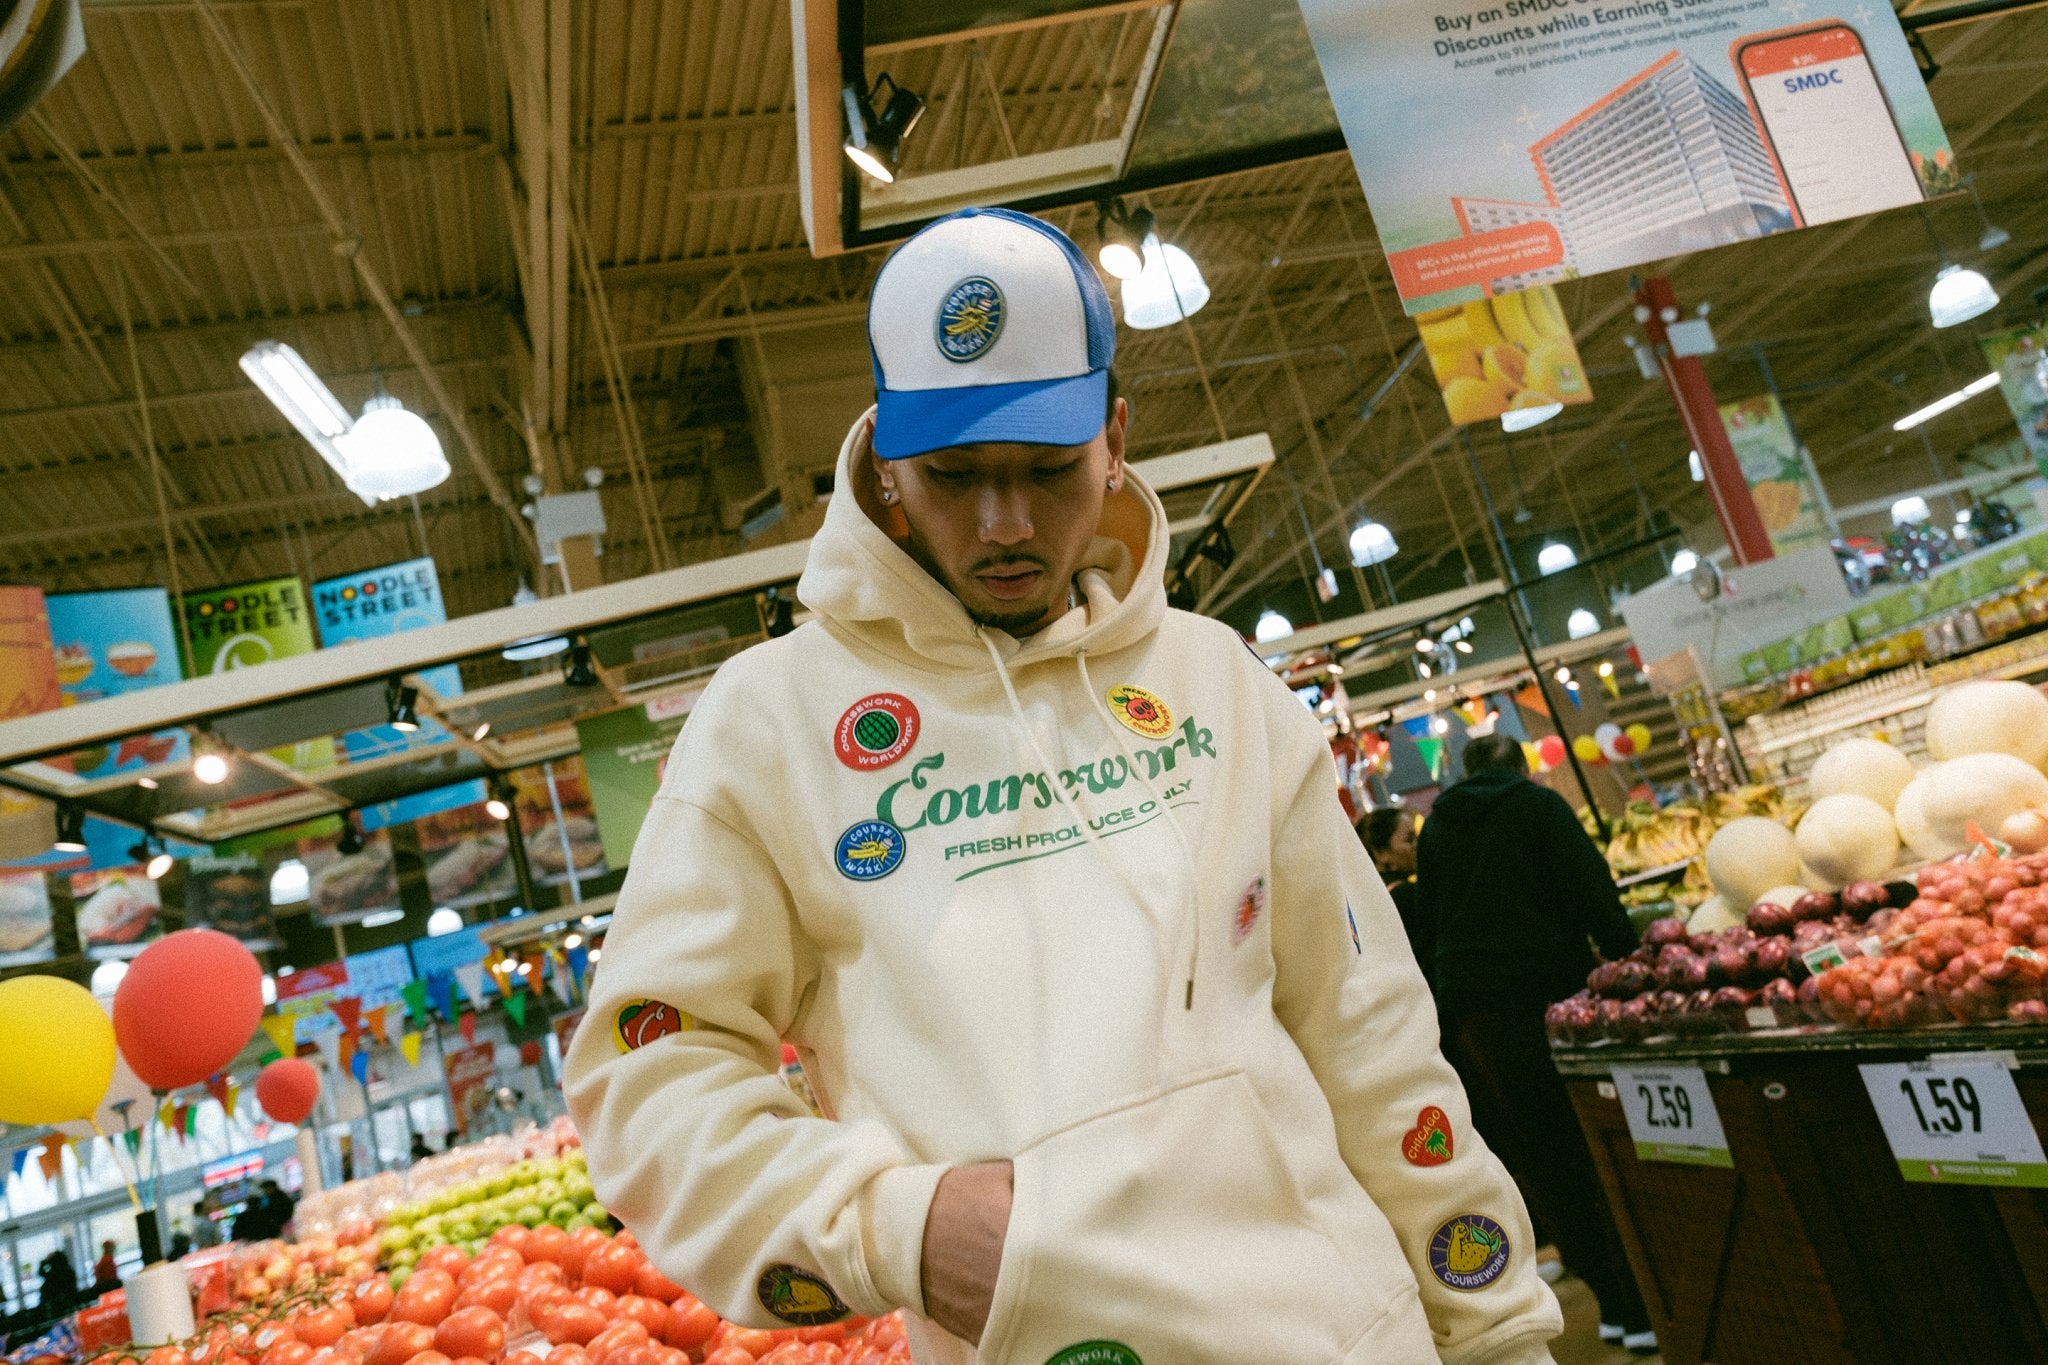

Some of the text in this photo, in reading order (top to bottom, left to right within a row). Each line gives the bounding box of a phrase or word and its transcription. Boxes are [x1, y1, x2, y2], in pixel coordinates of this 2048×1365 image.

[1434, 14, 1472, 32] Buy
[1477, 9, 1503, 23] an
[1434, 26, 1535, 57] Discounts
[1538, 13, 1590, 36] while
[1593, 0, 1669, 25] Earning
[1454, 53, 1497, 69] Access
[1499, 50, 1512, 61] to
[1528, 40, 1562, 57] prime
[1563, 28, 1622, 50] properties
[1624, 21, 1662, 35] across
[1494, 63, 1528, 78] enjoy
[1528, 53, 1577, 70] services
[1578, 46, 1608, 59] from
[1783, 68, 1843, 93] SMDC
[186, 606, 299, 640] TREET
[324, 585, 433, 628] STREET
[841, 697, 902, 753] COURSEWORK
[858, 716, 913, 765] WORLDWIDE
[876, 716, 1216, 832] Coursework
[850, 824, 894, 842] COURSE
[944, 835, 1022, 861] FRESH
[846, 861, 882, 875] WORK
[1637, 1084, 1693, 1130] 2.59
[1900, 1076, 1982, 1133] 1.59
[1407, 1108, 1442, 1160] CHICAGO
[1444, 1252, 1507, 1287] COURSEWORK
